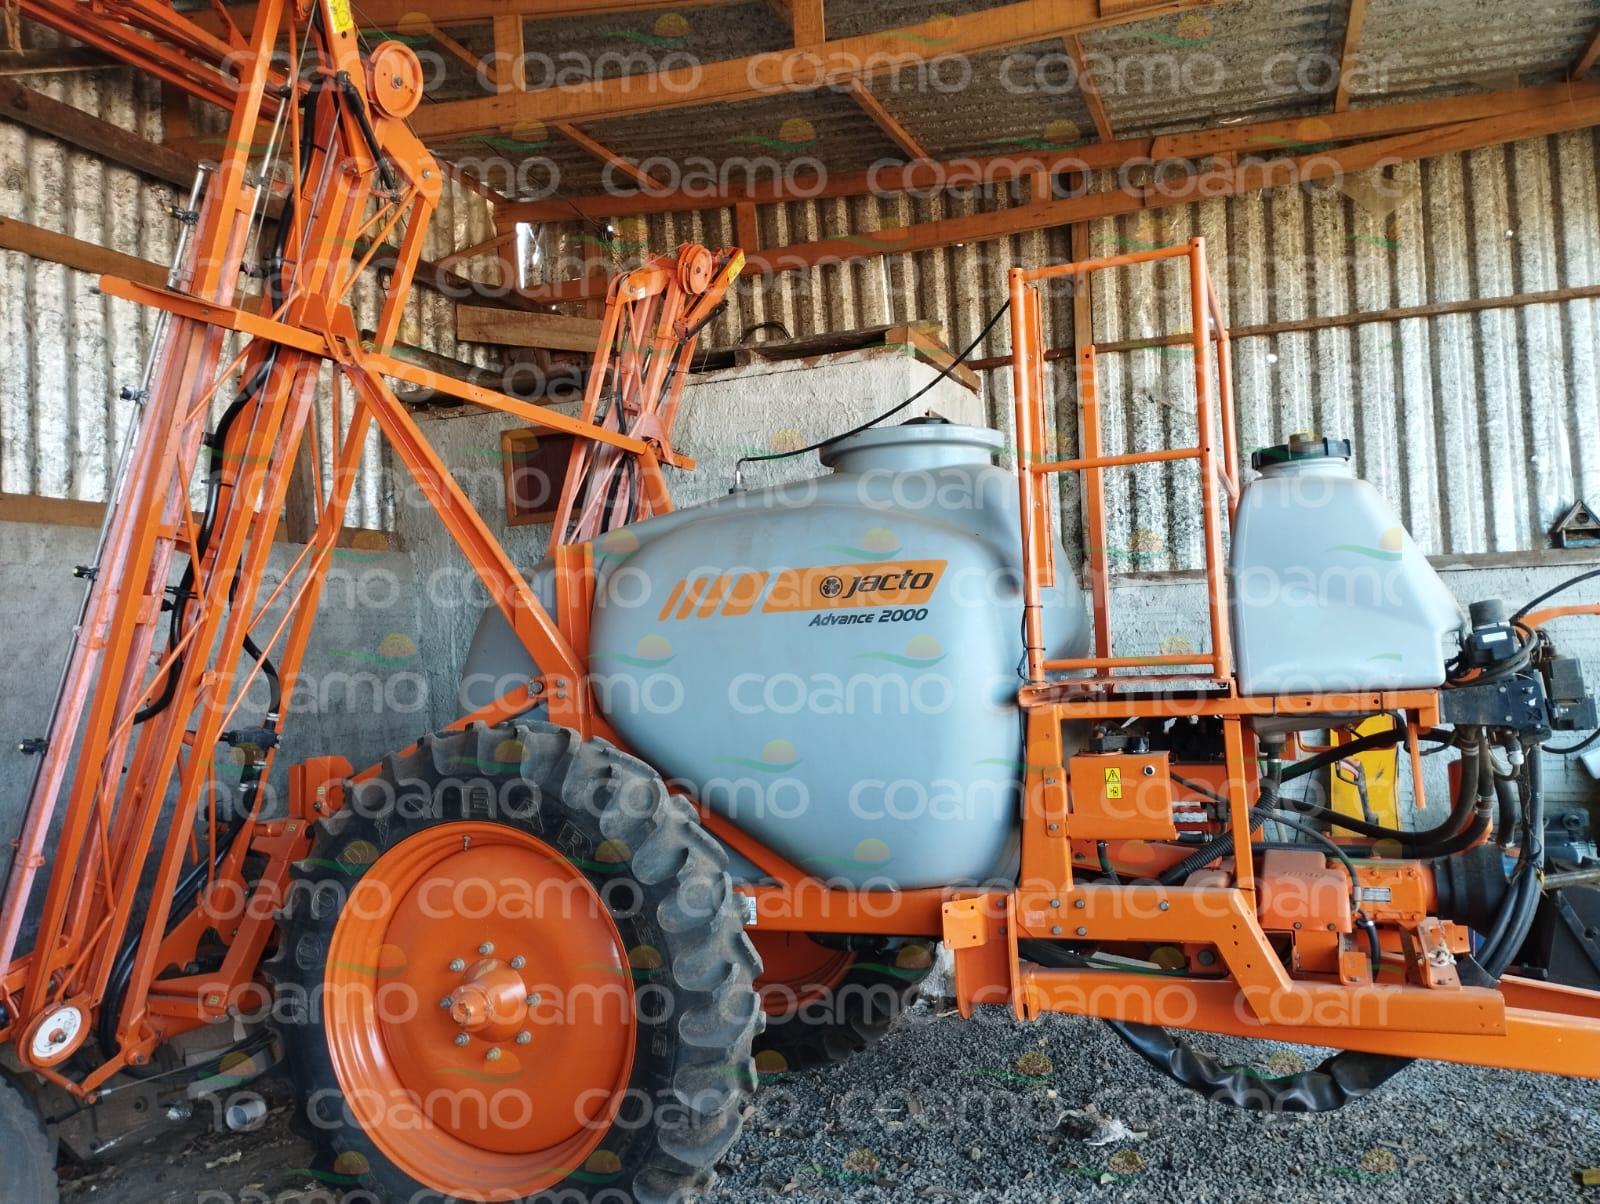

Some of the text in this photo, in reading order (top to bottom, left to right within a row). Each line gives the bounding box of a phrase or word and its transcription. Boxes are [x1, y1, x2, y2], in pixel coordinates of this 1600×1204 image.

[842, 569, 934, 598] jacto
[808, 608, 928, 627] Advance 2000
